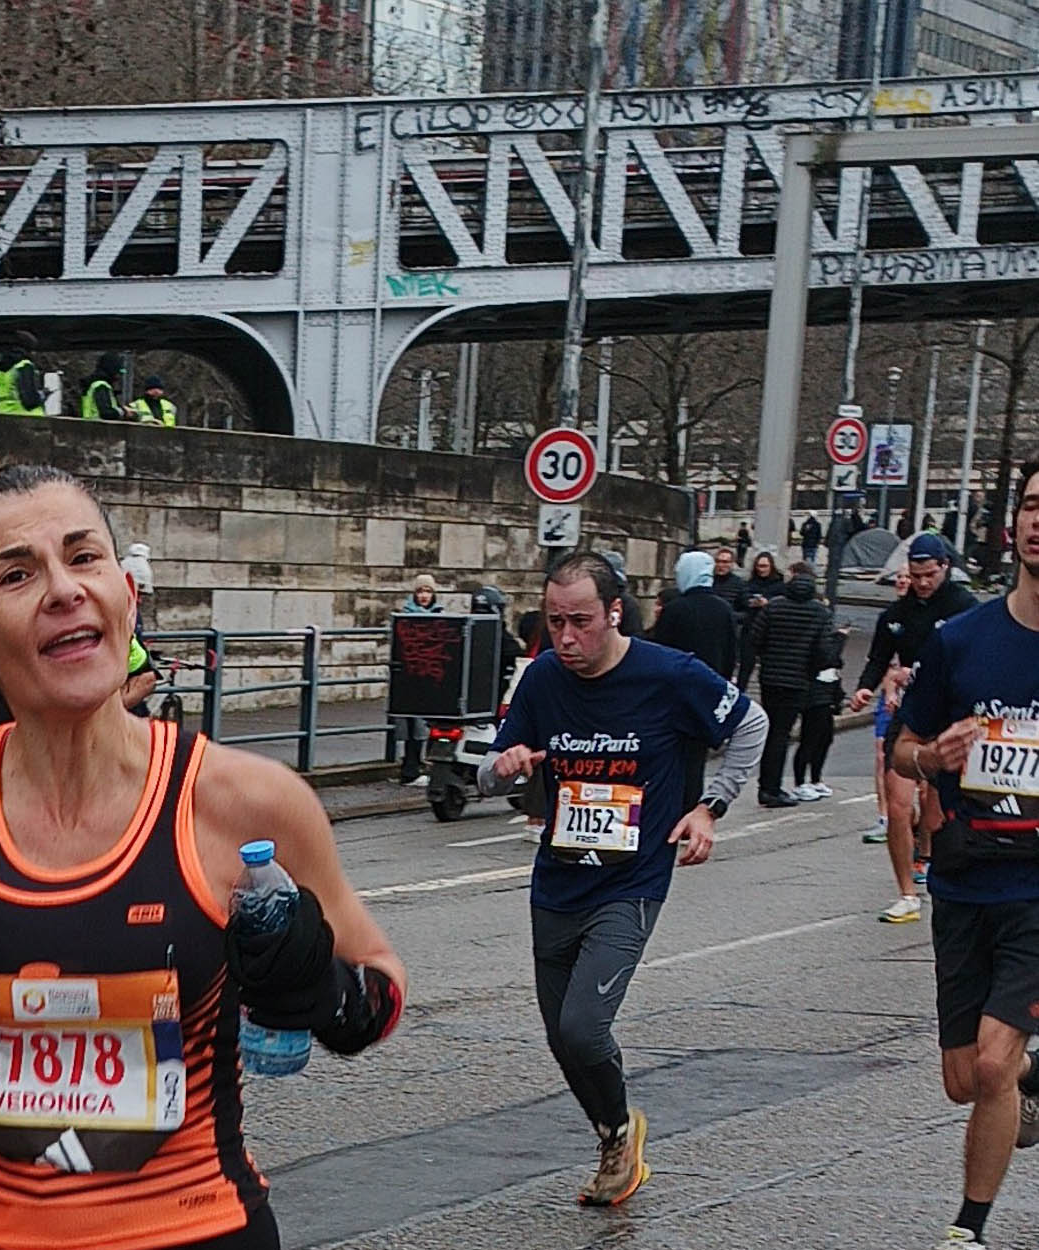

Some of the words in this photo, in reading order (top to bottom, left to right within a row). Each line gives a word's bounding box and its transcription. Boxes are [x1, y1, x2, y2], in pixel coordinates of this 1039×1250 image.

[541, 450, 582, 481] 30
[549, 732, 641, 753] #SemiParis
[608, 759, 638, 777] KM
[981, 744, 1039, 778] 19277
[566, 806, 614, 834] 21152
